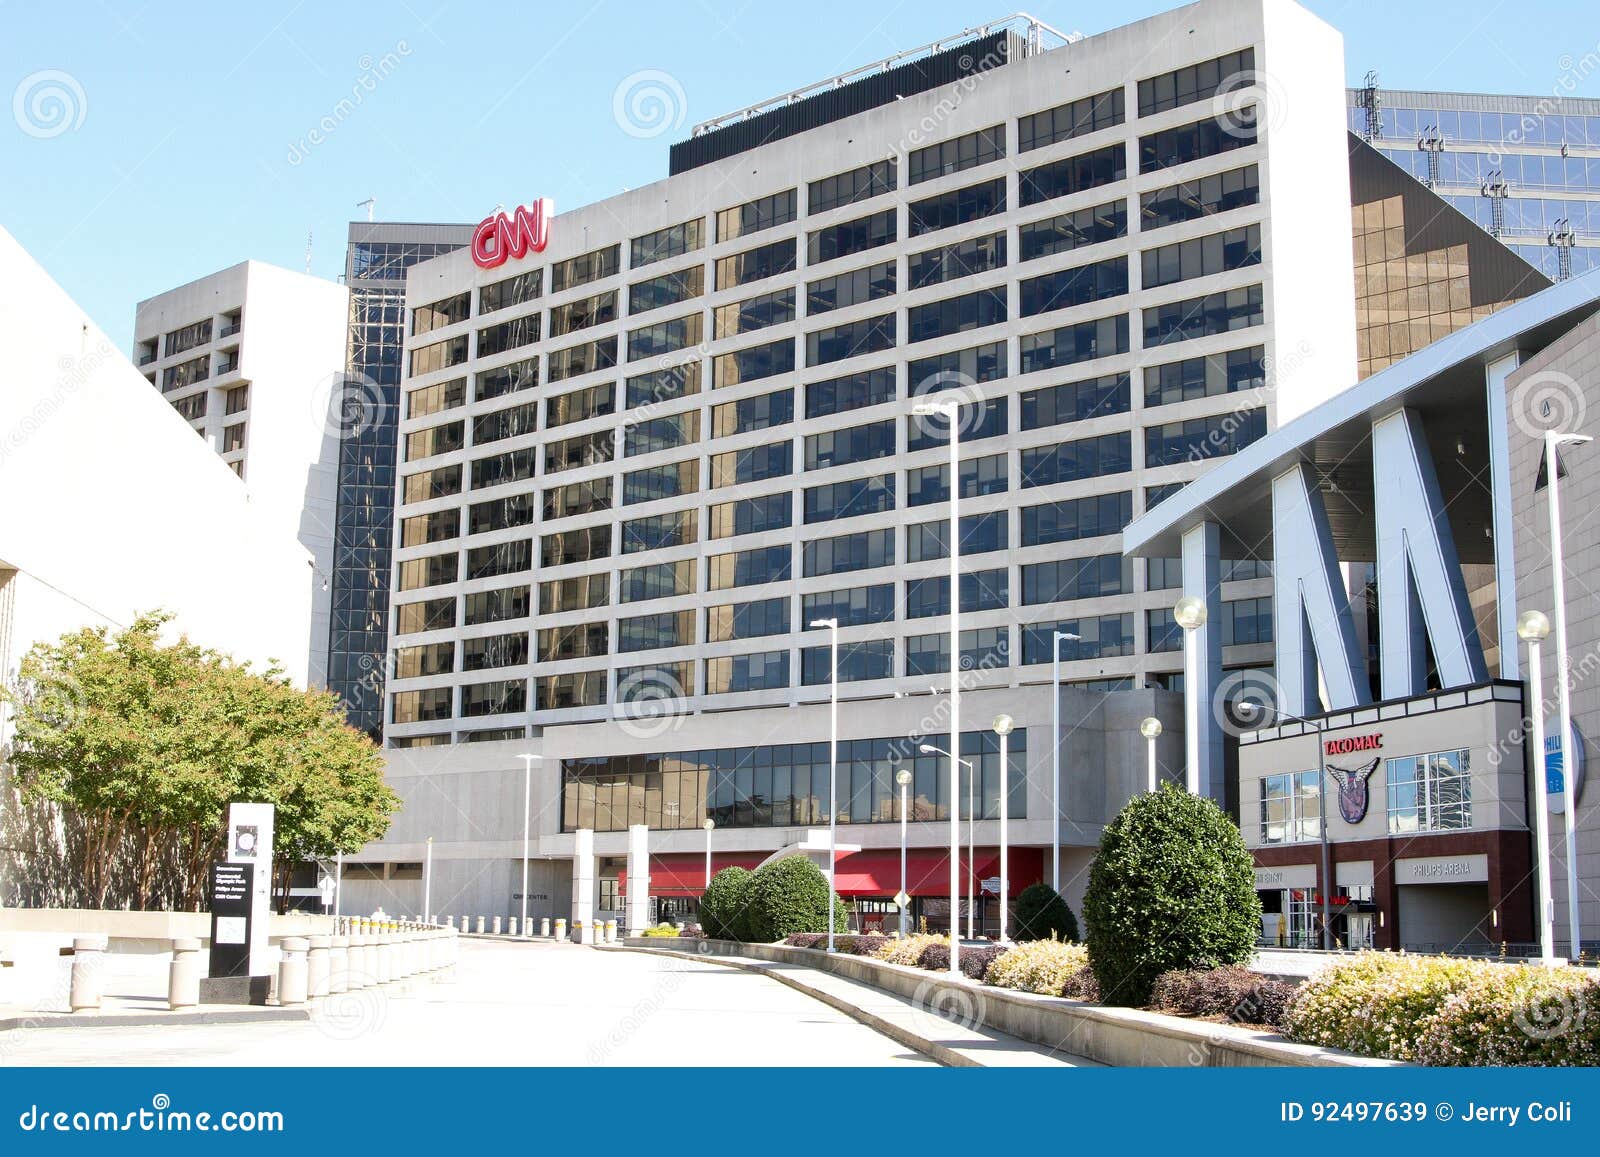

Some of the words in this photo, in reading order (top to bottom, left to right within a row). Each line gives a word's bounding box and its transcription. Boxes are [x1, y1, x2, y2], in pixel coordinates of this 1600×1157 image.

[471, 198, 548, 269] CNN
[1413, 864, 1442, 877] PHILIPS
[1445, 863, 1471, 875] ARENA
